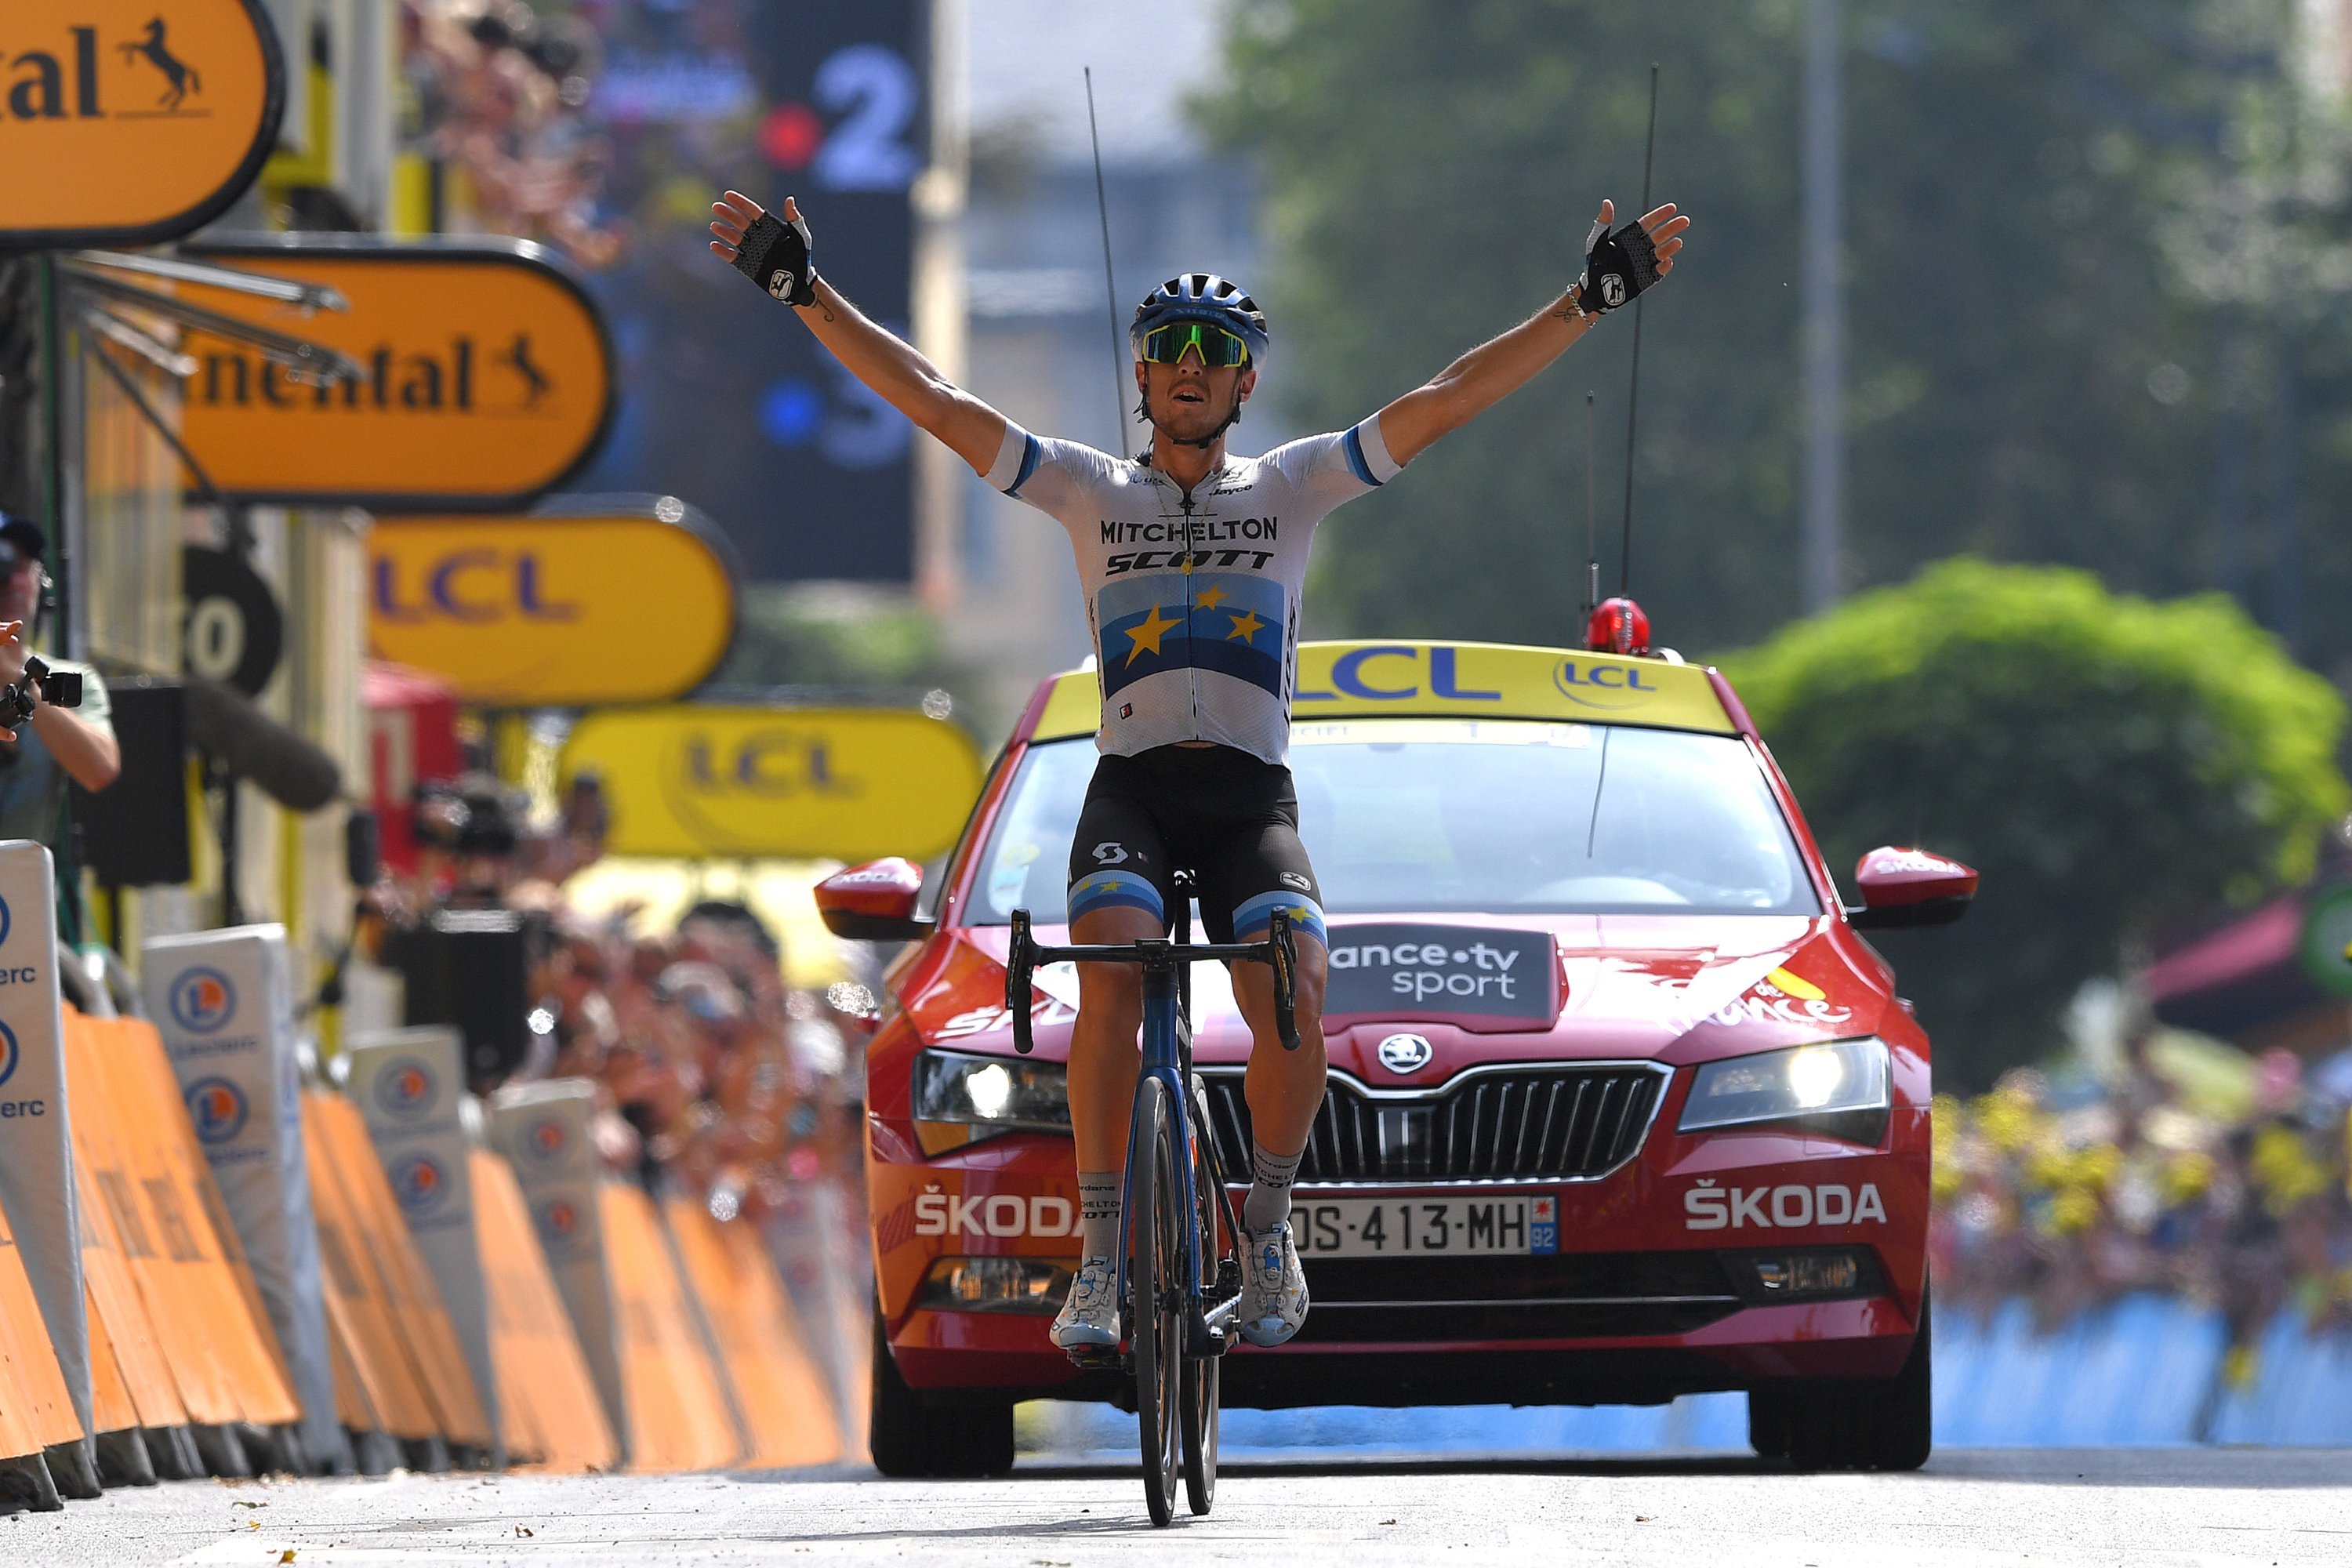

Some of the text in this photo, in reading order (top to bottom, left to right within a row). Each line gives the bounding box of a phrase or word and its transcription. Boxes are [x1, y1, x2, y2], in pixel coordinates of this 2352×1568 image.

[0, 25, 107, 120] al
[811, 42, 917, 192] 2
[1208, 485, 1253, 496] Jayco
[1101, 516, 1279, 545] MITCHELTON
[1105, 548, 1276, 577] SCOTT
[370, 546, 580, 625] LCL
[1565, 662, 1657, 691] LCL
[682, 729, 866, 800] LCL
[1392, 971, 1517, 1002] sport
[1684, 1179, 1887, 1231] ŠKODA
[1530, 1228, 1554, 1248] 92
